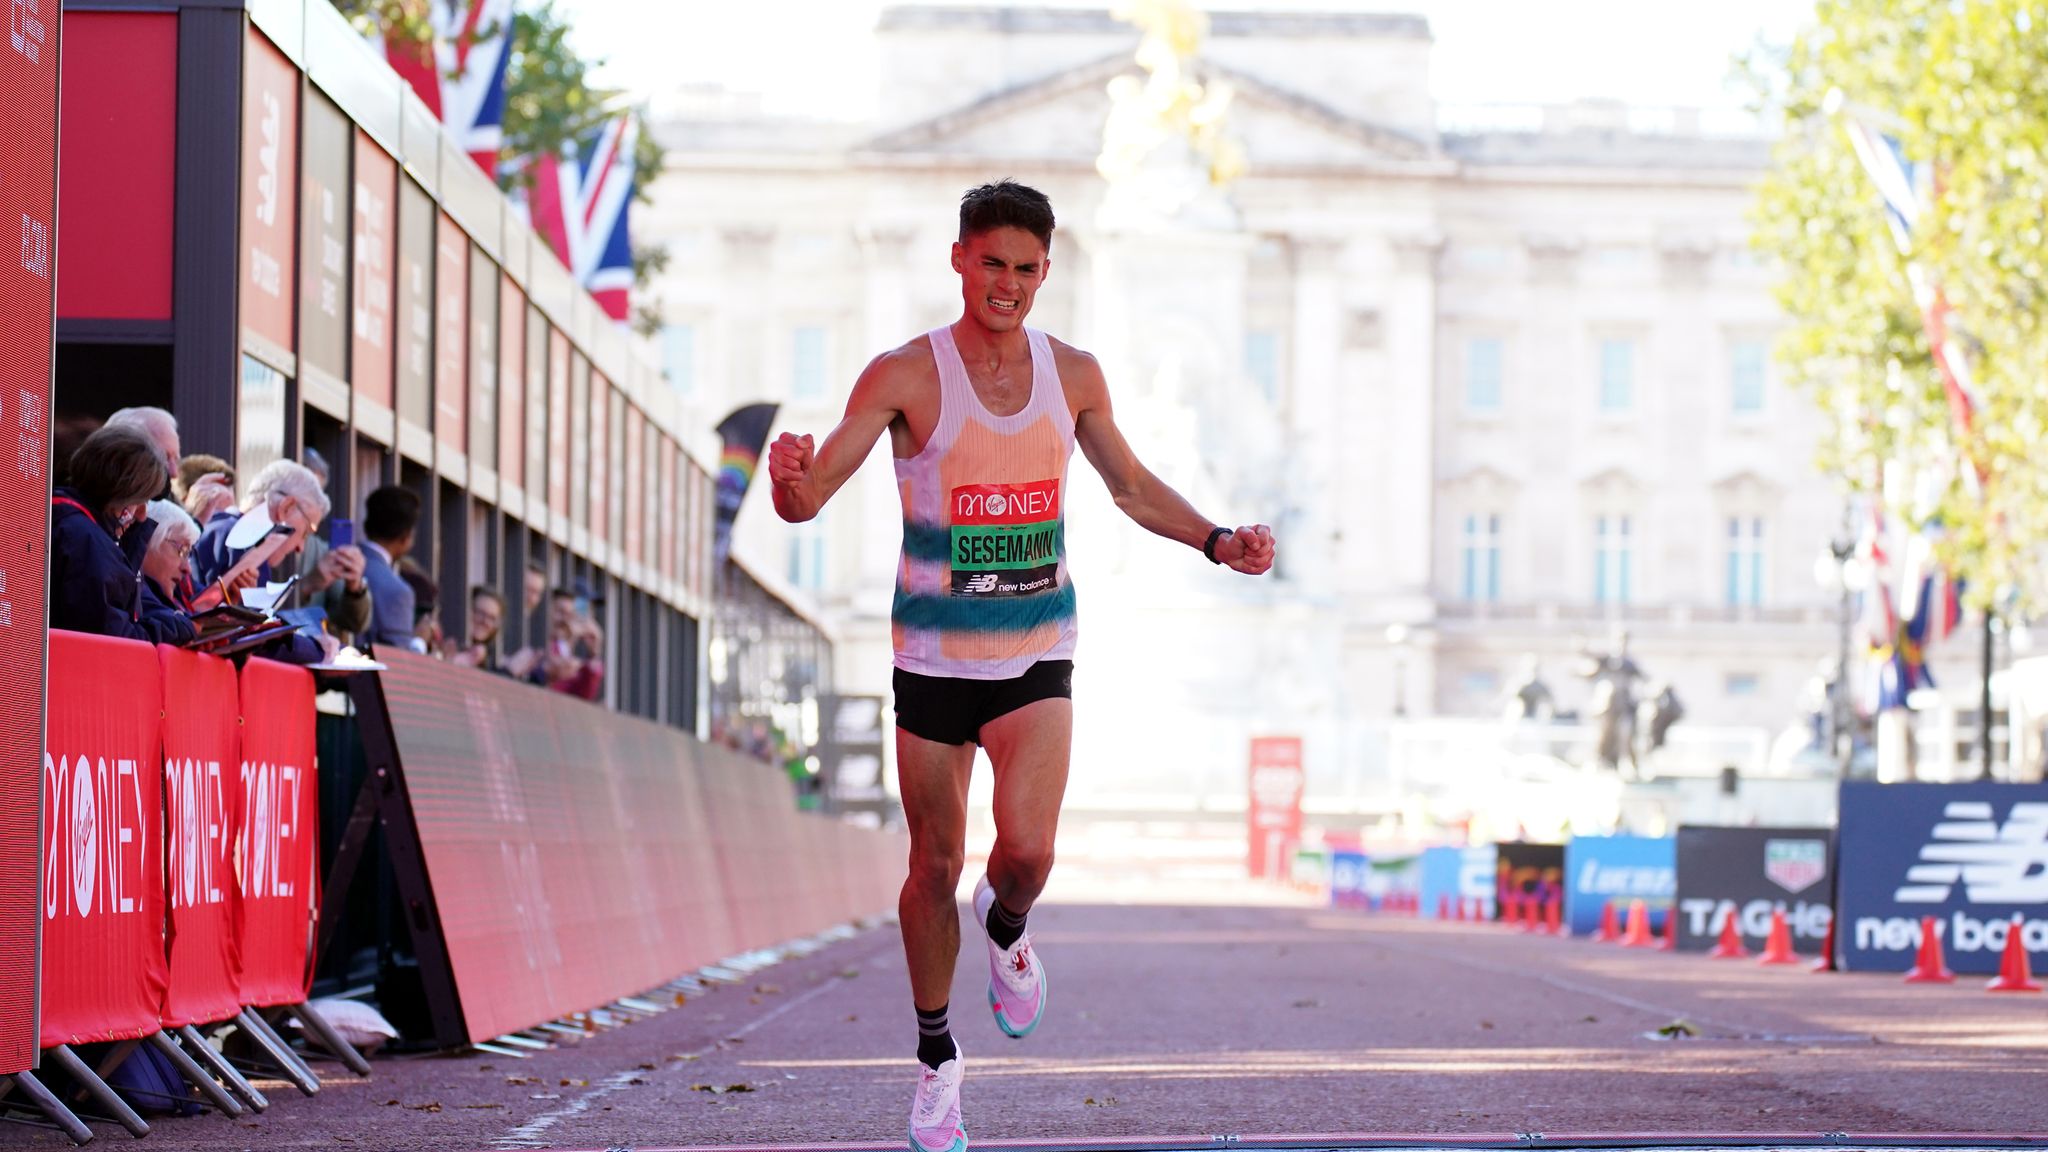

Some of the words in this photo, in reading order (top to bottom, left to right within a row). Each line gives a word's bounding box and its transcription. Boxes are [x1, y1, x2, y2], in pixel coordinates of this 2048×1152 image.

[958, 489, 1055, 516] MONEY
[958, 530, 1054, 564] SESEMANN
[998, 584, 1018, 592] new
[1020, 577, 1050, 592] balance
[45, 752, 146, 919] MONEY
